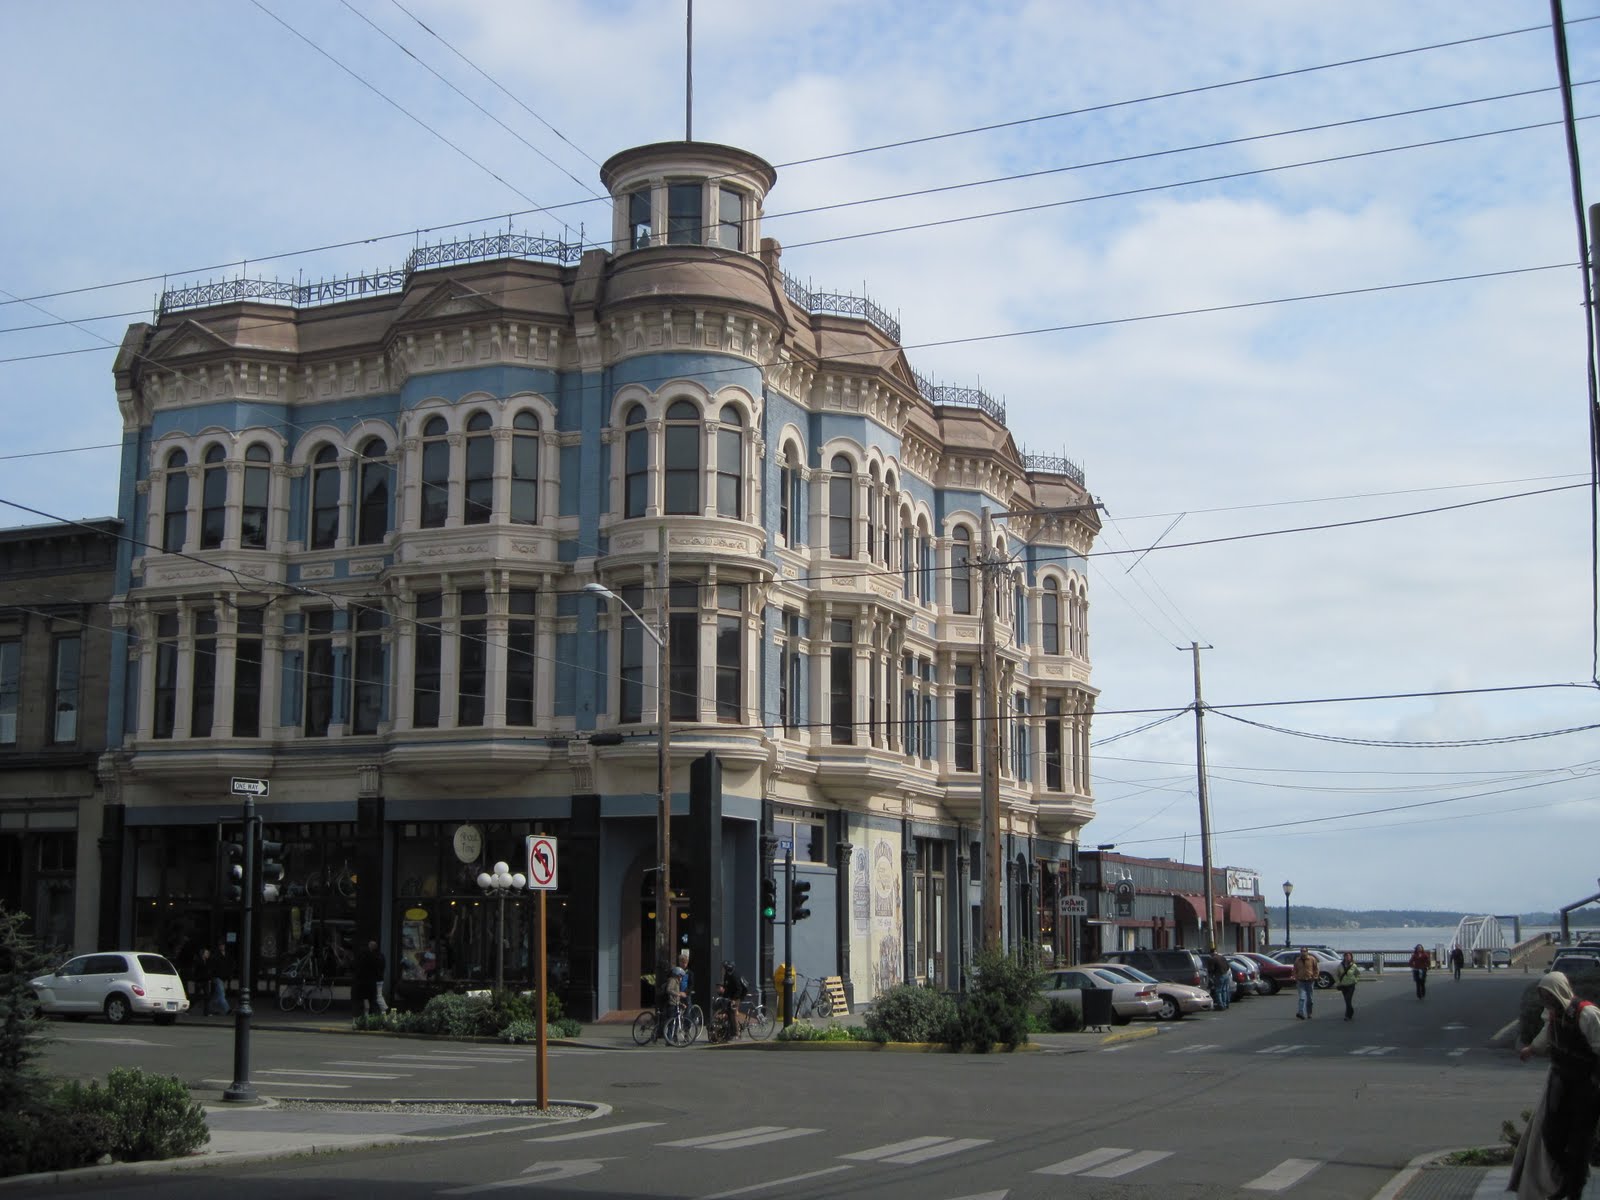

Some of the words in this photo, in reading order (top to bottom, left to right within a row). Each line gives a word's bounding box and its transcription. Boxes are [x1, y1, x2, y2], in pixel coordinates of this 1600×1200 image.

[308, 272, 403, 301] HASTINGS
[236, 782, 246, 790] ONE
[247, 783, 258, 791] WAY
[1061, 898, 1085, 907] FRAME
